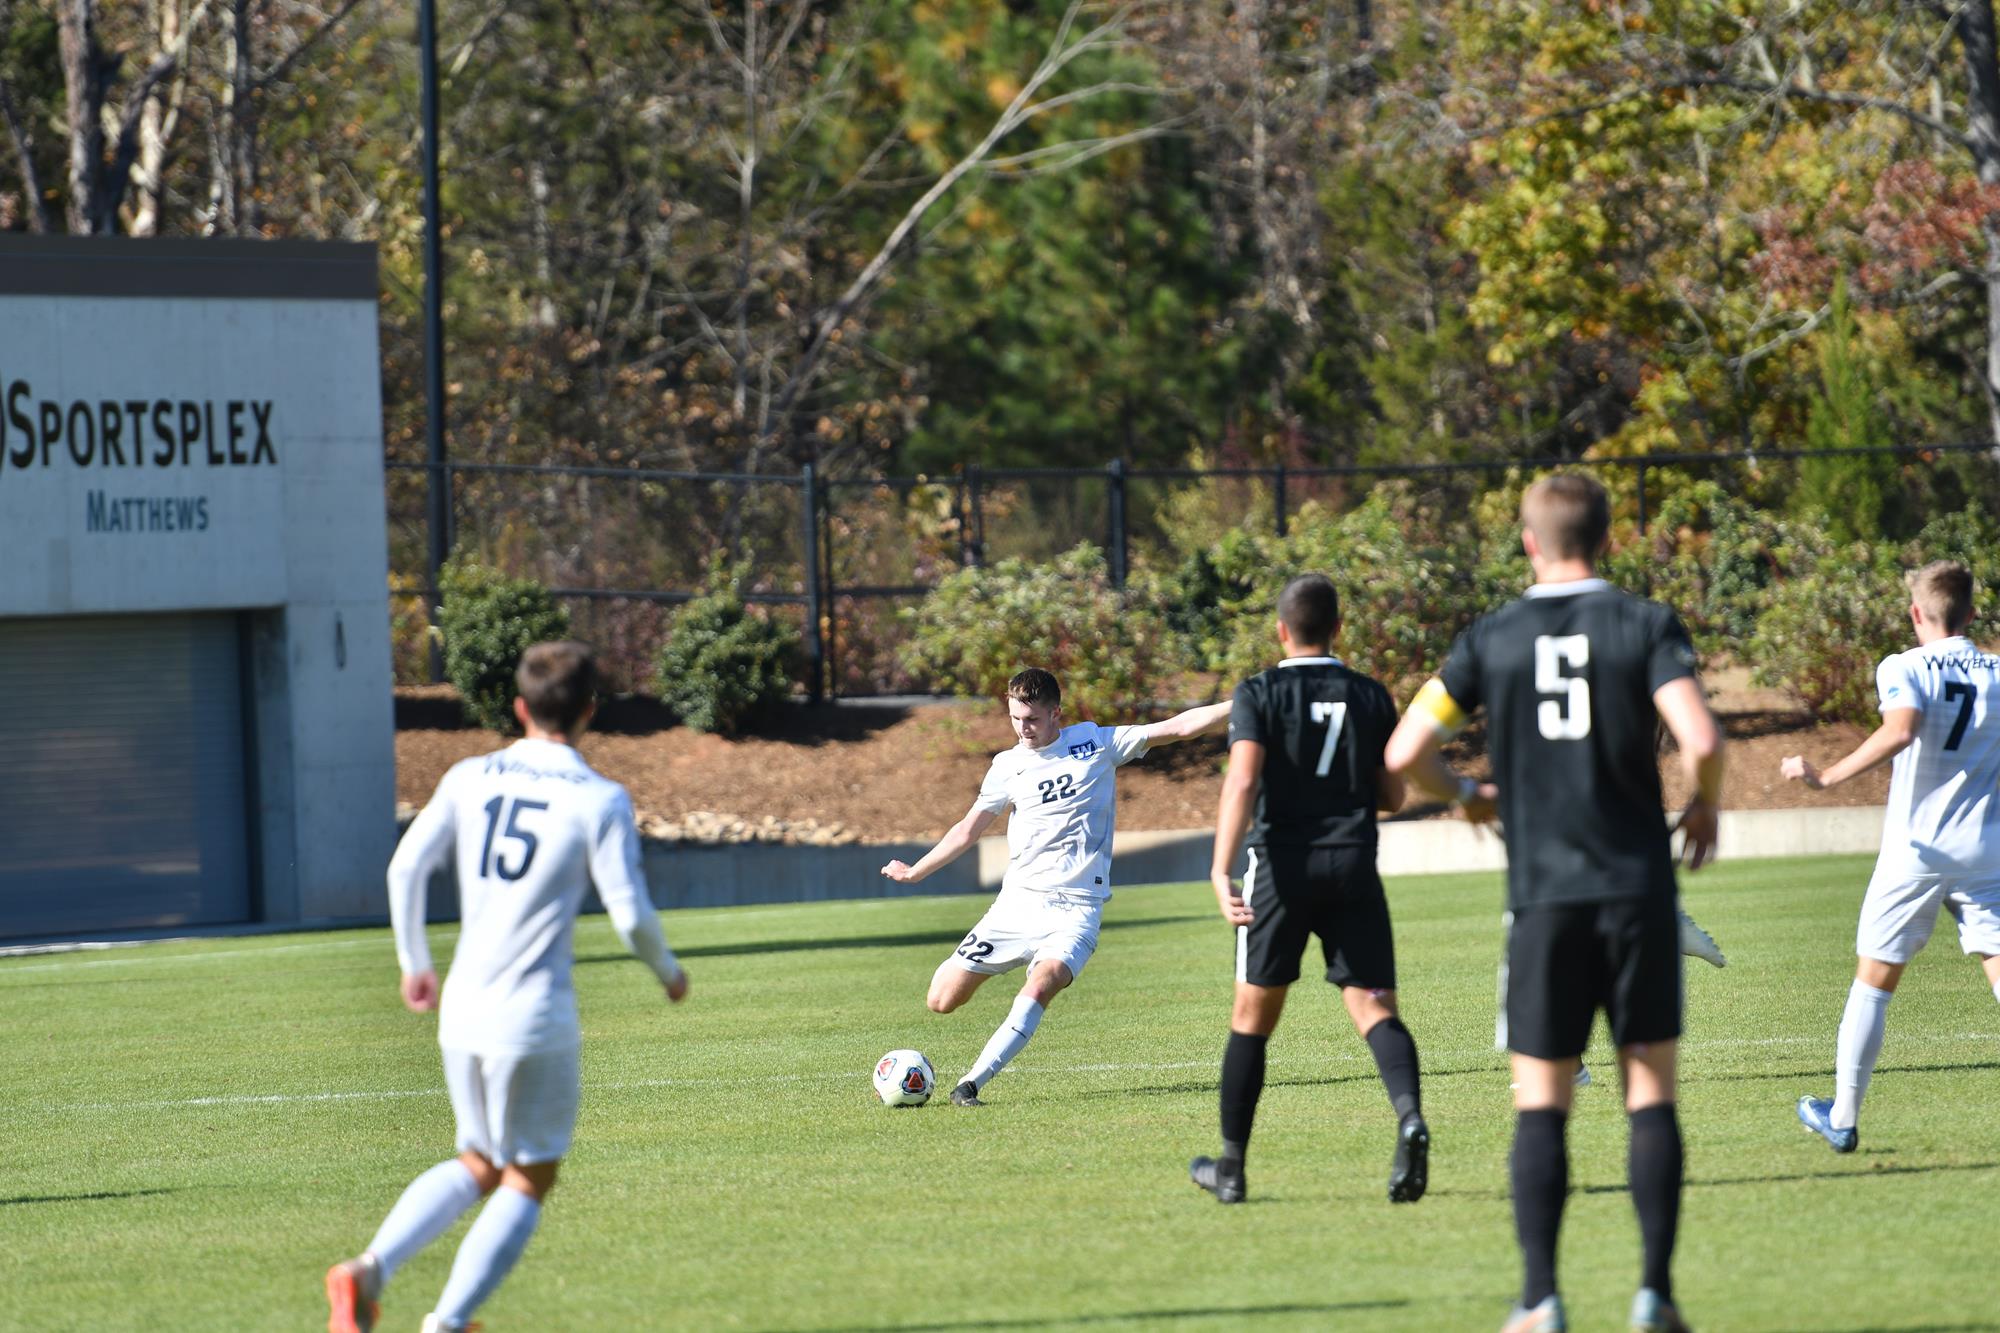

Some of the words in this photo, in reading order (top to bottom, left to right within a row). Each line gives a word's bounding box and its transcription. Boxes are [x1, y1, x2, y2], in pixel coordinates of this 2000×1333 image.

[8, 379, 278, 469] SPORTSPLEX
[86, 488, 209, 533] MATTHEWS
[1535, 633, 1591, 740] 5
[1943, 680, 1977, 751] 7
[1310, 701, 1347, 777] 7
[1038, 773, 1077, 804] 22
[480, 794, 549, 881] 15
[957, 933, 994, 963] 22
